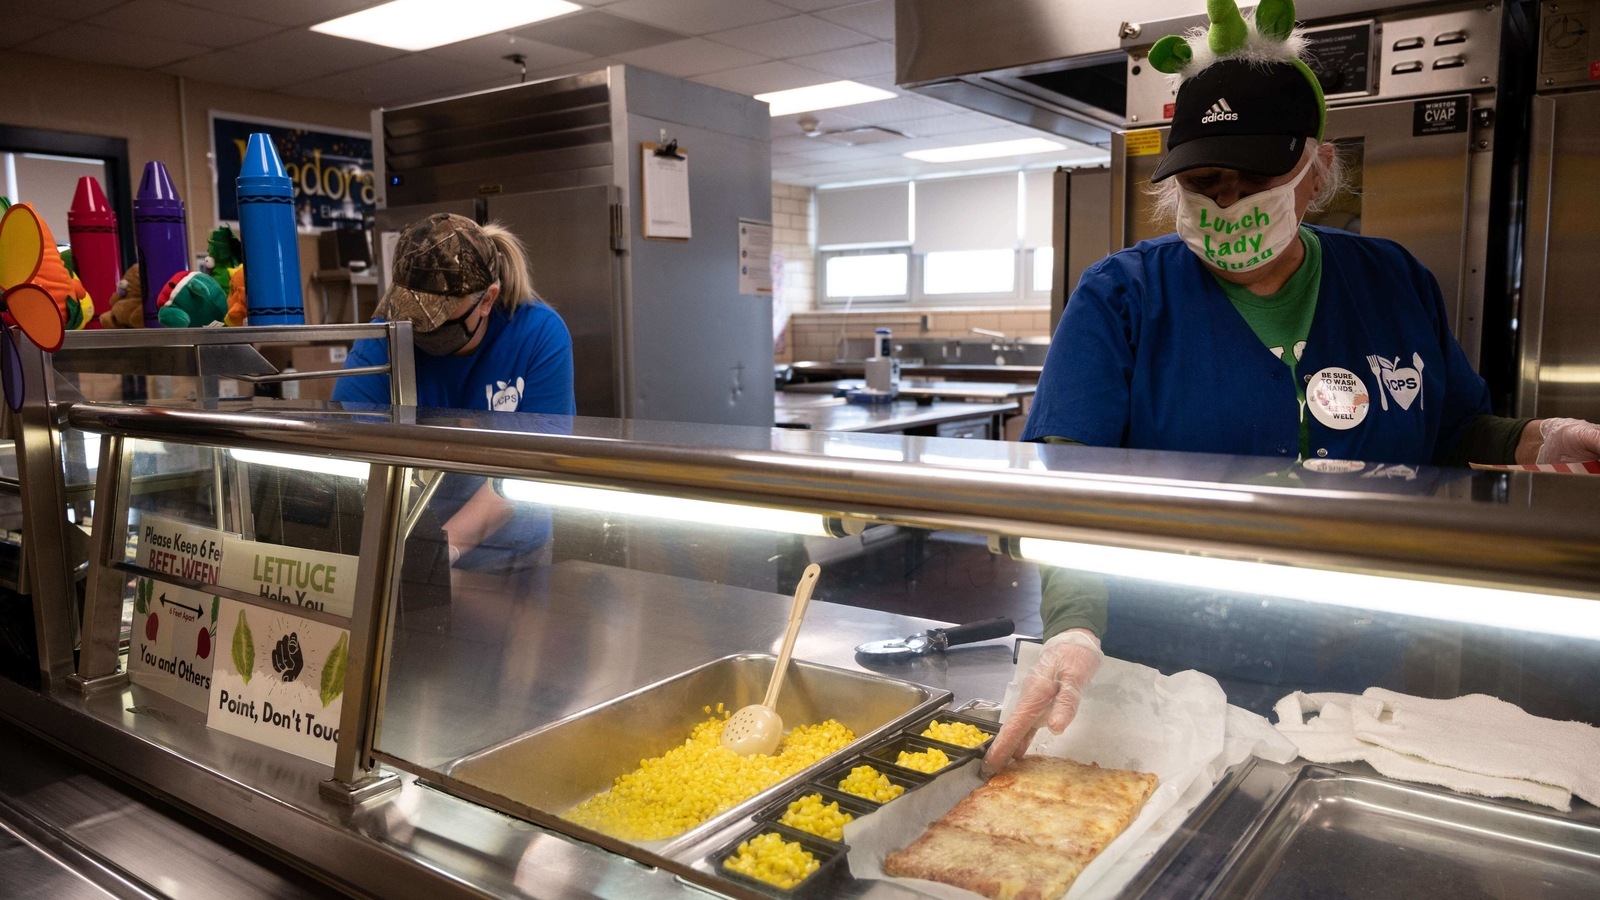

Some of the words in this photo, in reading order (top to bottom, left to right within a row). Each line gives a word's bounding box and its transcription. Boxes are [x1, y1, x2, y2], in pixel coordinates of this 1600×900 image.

[1201, 111, 1238, 124] adidas
[1424, 108, 1456, 122] CVAP
[1425, 101, 1456, 109] WINSTON
[1199, 206, 1270, 234] Lunch
[1204, 233, 1263, 257] Lady
[145, 526, 171, 549] Please
[173, 533, 198, 560] Keep
[200, 540, 207, 558] 6
[208, 541, 220, 562] Fe
[253, 554, 337, 594] LETTUCE
[173, 608, 183, 618] Feet
[182, 612, 195, 622] Apart
[141, 643, 157, 667] You
[158, 656, 177, 675] and
[178, 659, 211, 690] Others
[219, 689, 258, 724] Point,
[262, 701, 302, 733] Don't
[305, 712, 340, 744] Touc
